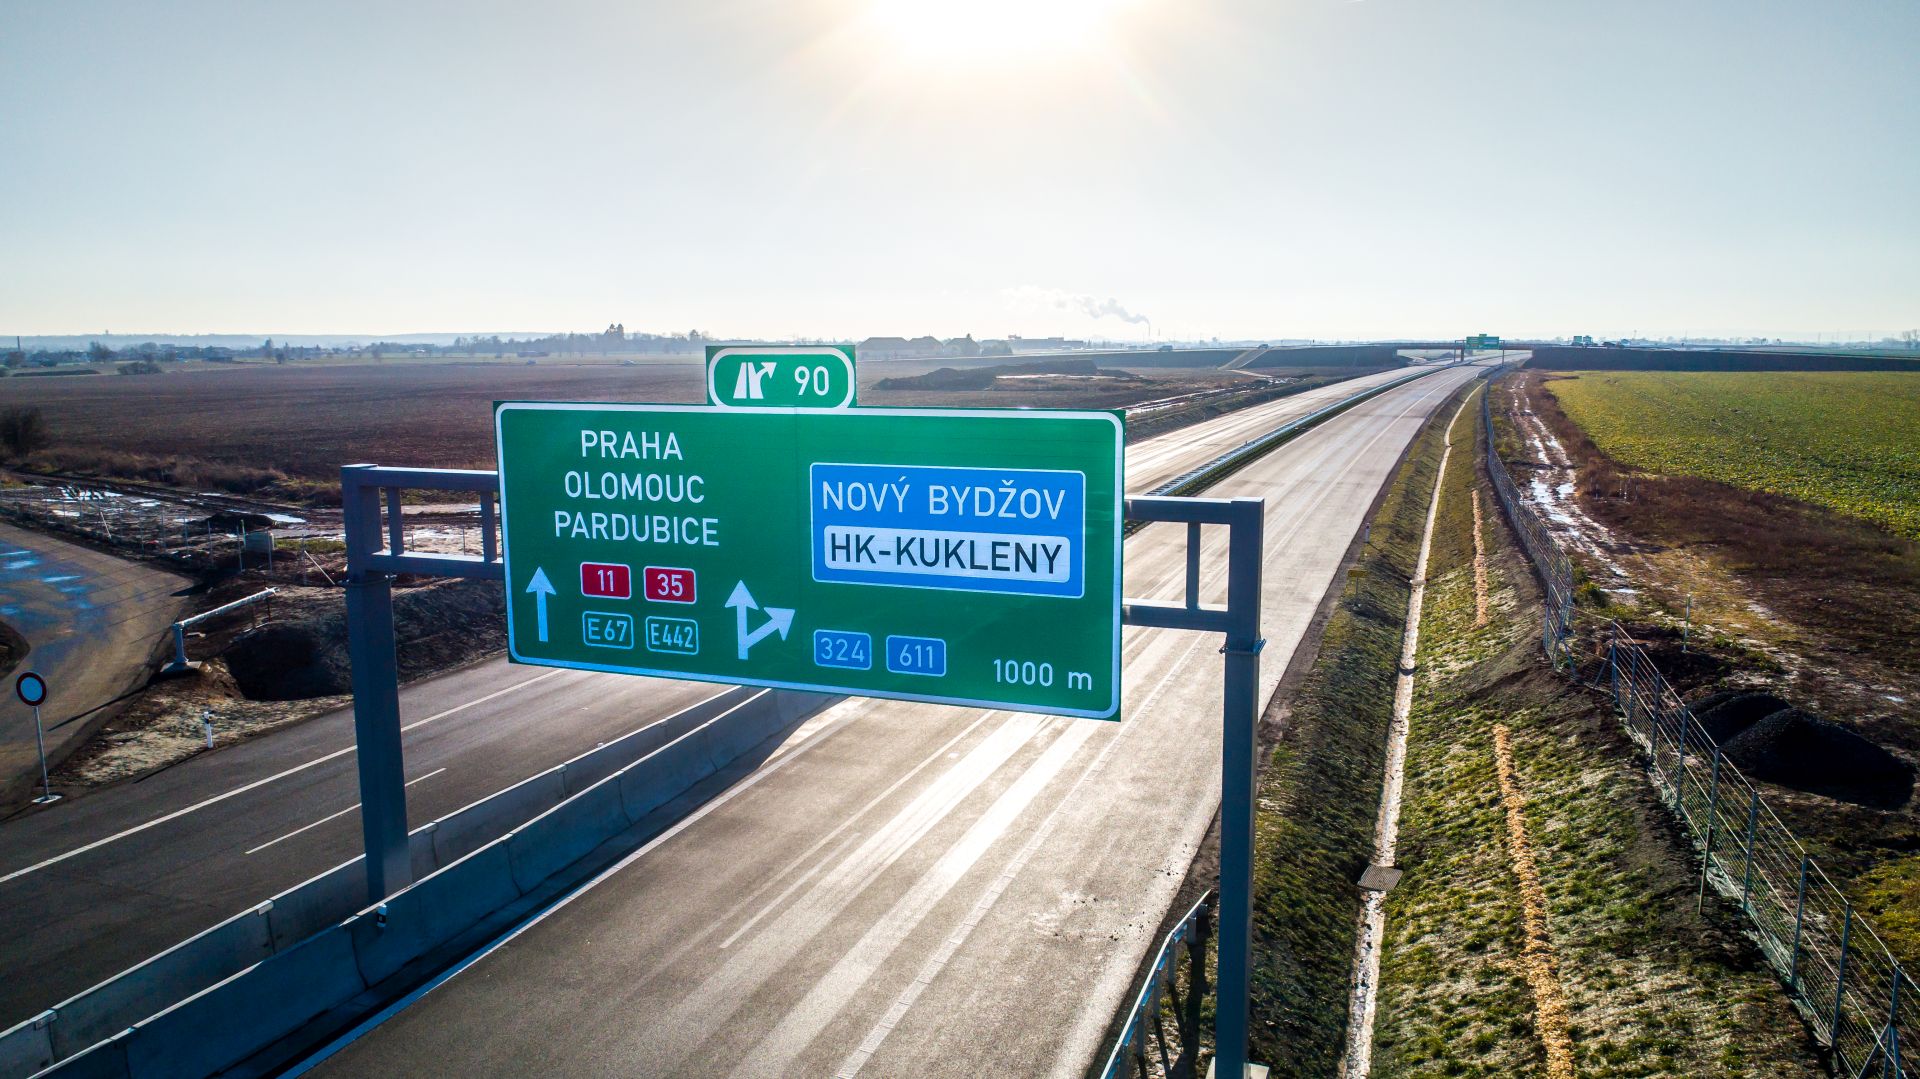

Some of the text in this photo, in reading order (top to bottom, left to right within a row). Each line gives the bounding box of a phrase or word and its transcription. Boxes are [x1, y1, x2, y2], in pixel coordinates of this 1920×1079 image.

[794, 365, 829, 396] 90
[581, 430, 683, 460] PRAHA
[564, 471, 705, 503] OLOMOUC
[822, 476, 1066, 520] NOVÝ BYDŽOV
[554, 511, 719, 546] PARDUBICE
[830, 533, 1062, 574] HK-KUKLENY
[597, 569, 615, 592] 11
[657, 574, 683, 596] 35
[650, 623, 694, 648] E442
[820, 638, 865, 662] 324
[900, 644, 933, 668] 611
[993, 659, 1092, 690] 1000 m
